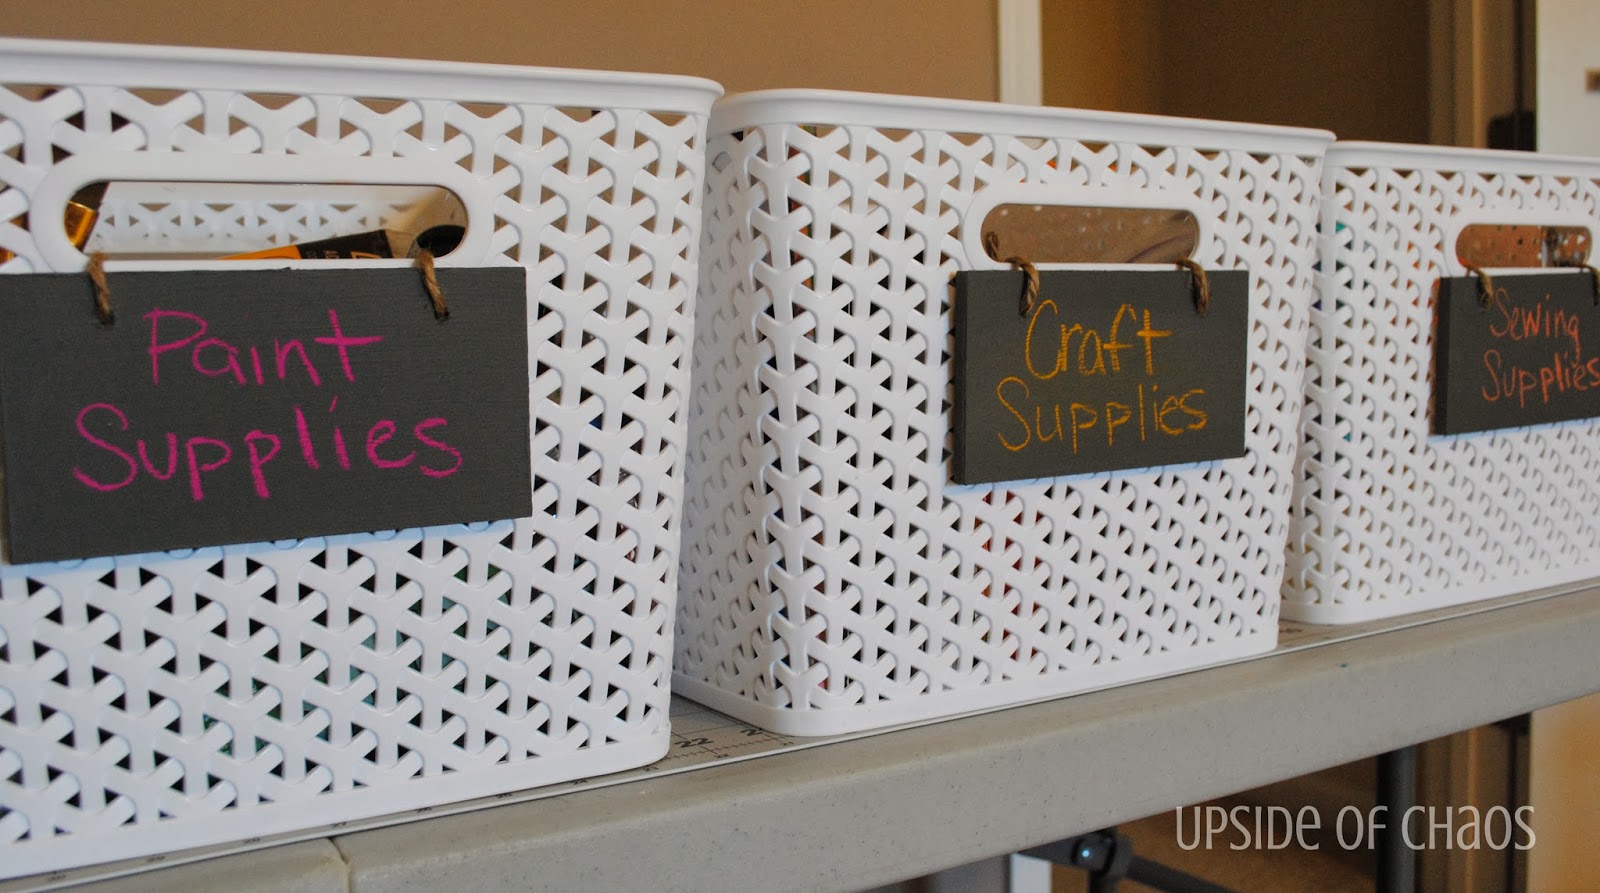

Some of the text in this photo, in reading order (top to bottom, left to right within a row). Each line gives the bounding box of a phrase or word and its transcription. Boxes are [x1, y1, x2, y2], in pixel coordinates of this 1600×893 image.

[143, 308, 384, 386] Paint
[1025, 299, 1172, 380] Craft
[1490, 288, 1582, 369] Sewing
[997, 376, 1208, 455] Supplies
[1482, 349, 1600, 408] Supplies
[73, 397, 463, 501] Supplies
[675, 737, 713, 748] 22
